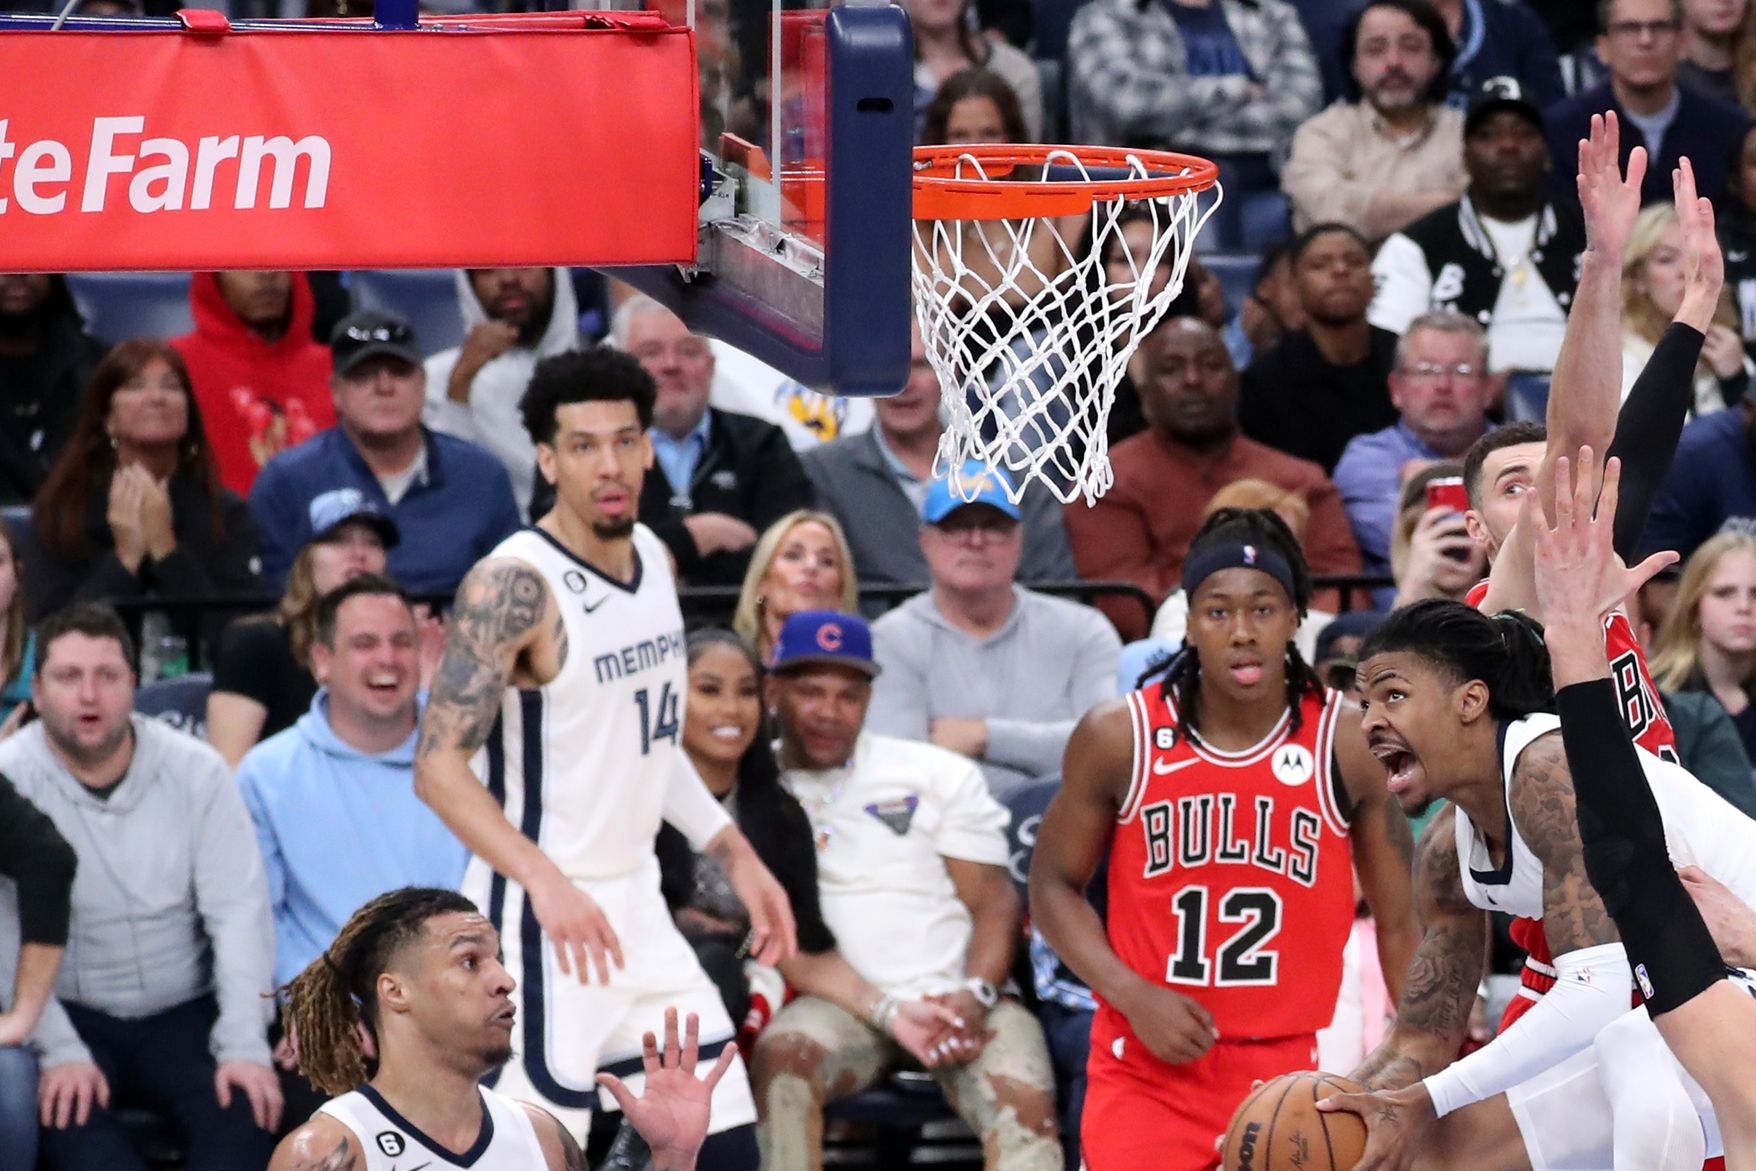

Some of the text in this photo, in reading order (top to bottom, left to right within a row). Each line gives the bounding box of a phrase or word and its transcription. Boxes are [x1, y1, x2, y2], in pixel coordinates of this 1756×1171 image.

[81, 115, 332, 213] Farm
[815, 622, 843, 651] C
[634, 680, 679, 756] 14
[1155, 727, 1175, 750] 6
[1140, 793, 1321, 888] BULLS
[1165, 884, 1283, 987] 12
[380, 1133, 403, 1157] 6
